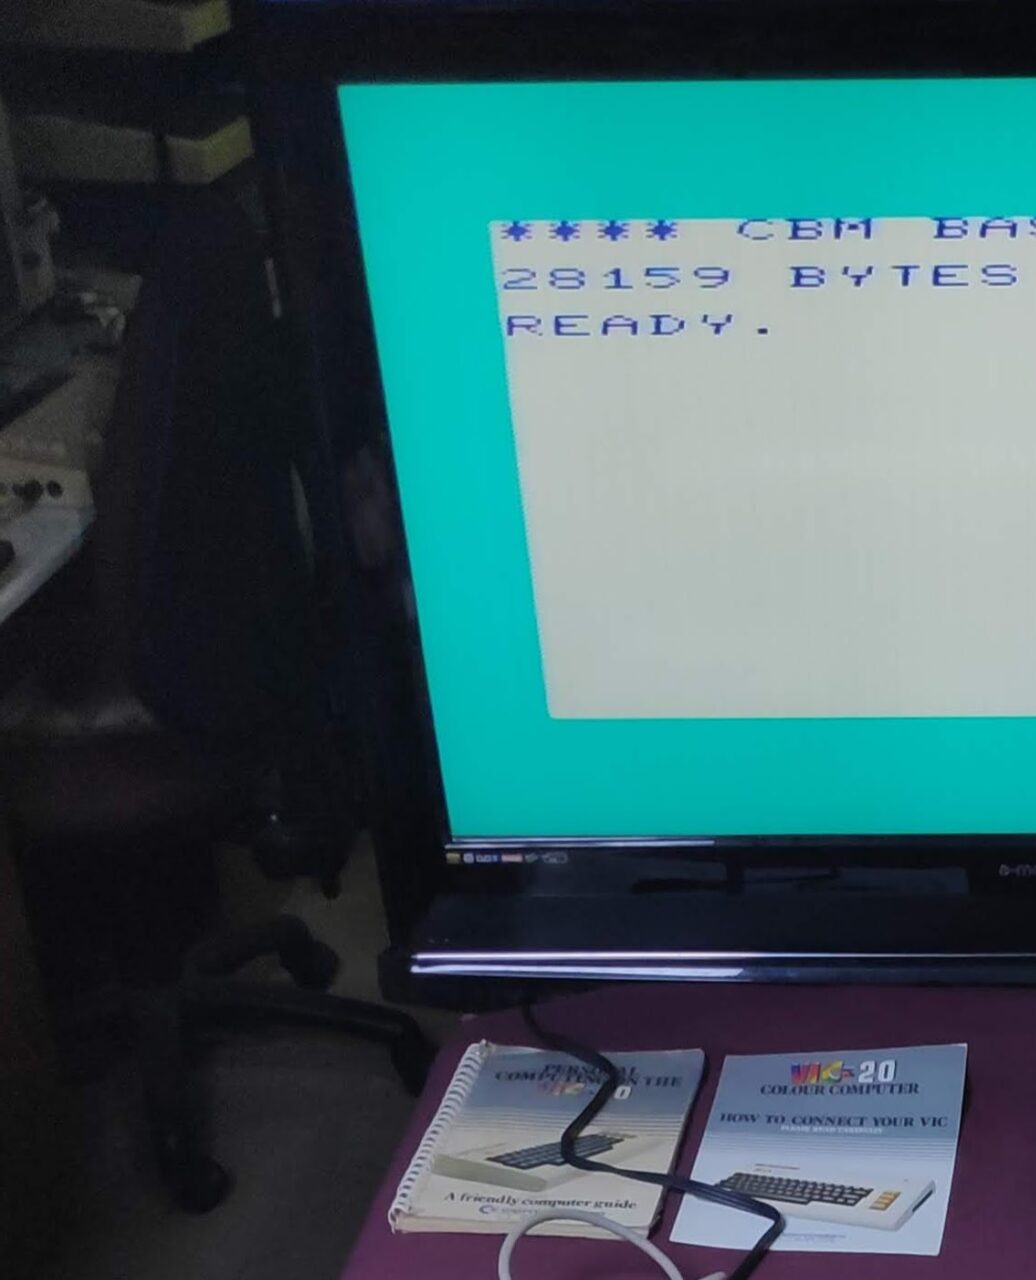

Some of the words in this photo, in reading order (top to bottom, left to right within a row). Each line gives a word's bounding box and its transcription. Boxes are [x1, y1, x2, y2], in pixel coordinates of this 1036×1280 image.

[737, 218, 873, 240] CBM
[502, 267, 731, 290] 28159
[790, 264, 1019, 288] BYTES
[506, 314, 769, 337] READY.
[760, 1084, 826, 1096] COLOUR
[829, 1083, 920, 1096] COMPUTER
[719, 1112, 759, 1123] HOW
[765, 1114, 786, 1125] TO
[791, 1115, 868, 1127] CONNECT
[873, 1116, 915, 1127] YOUR
[919, 1116, 949, 1128] VIC
[445, 1192, 456, 1201] A
[459, 1192, 518, 1206] friendly
[521, 1199, 589, 1209] computer
[592, 1199, 638, 1210] guide
